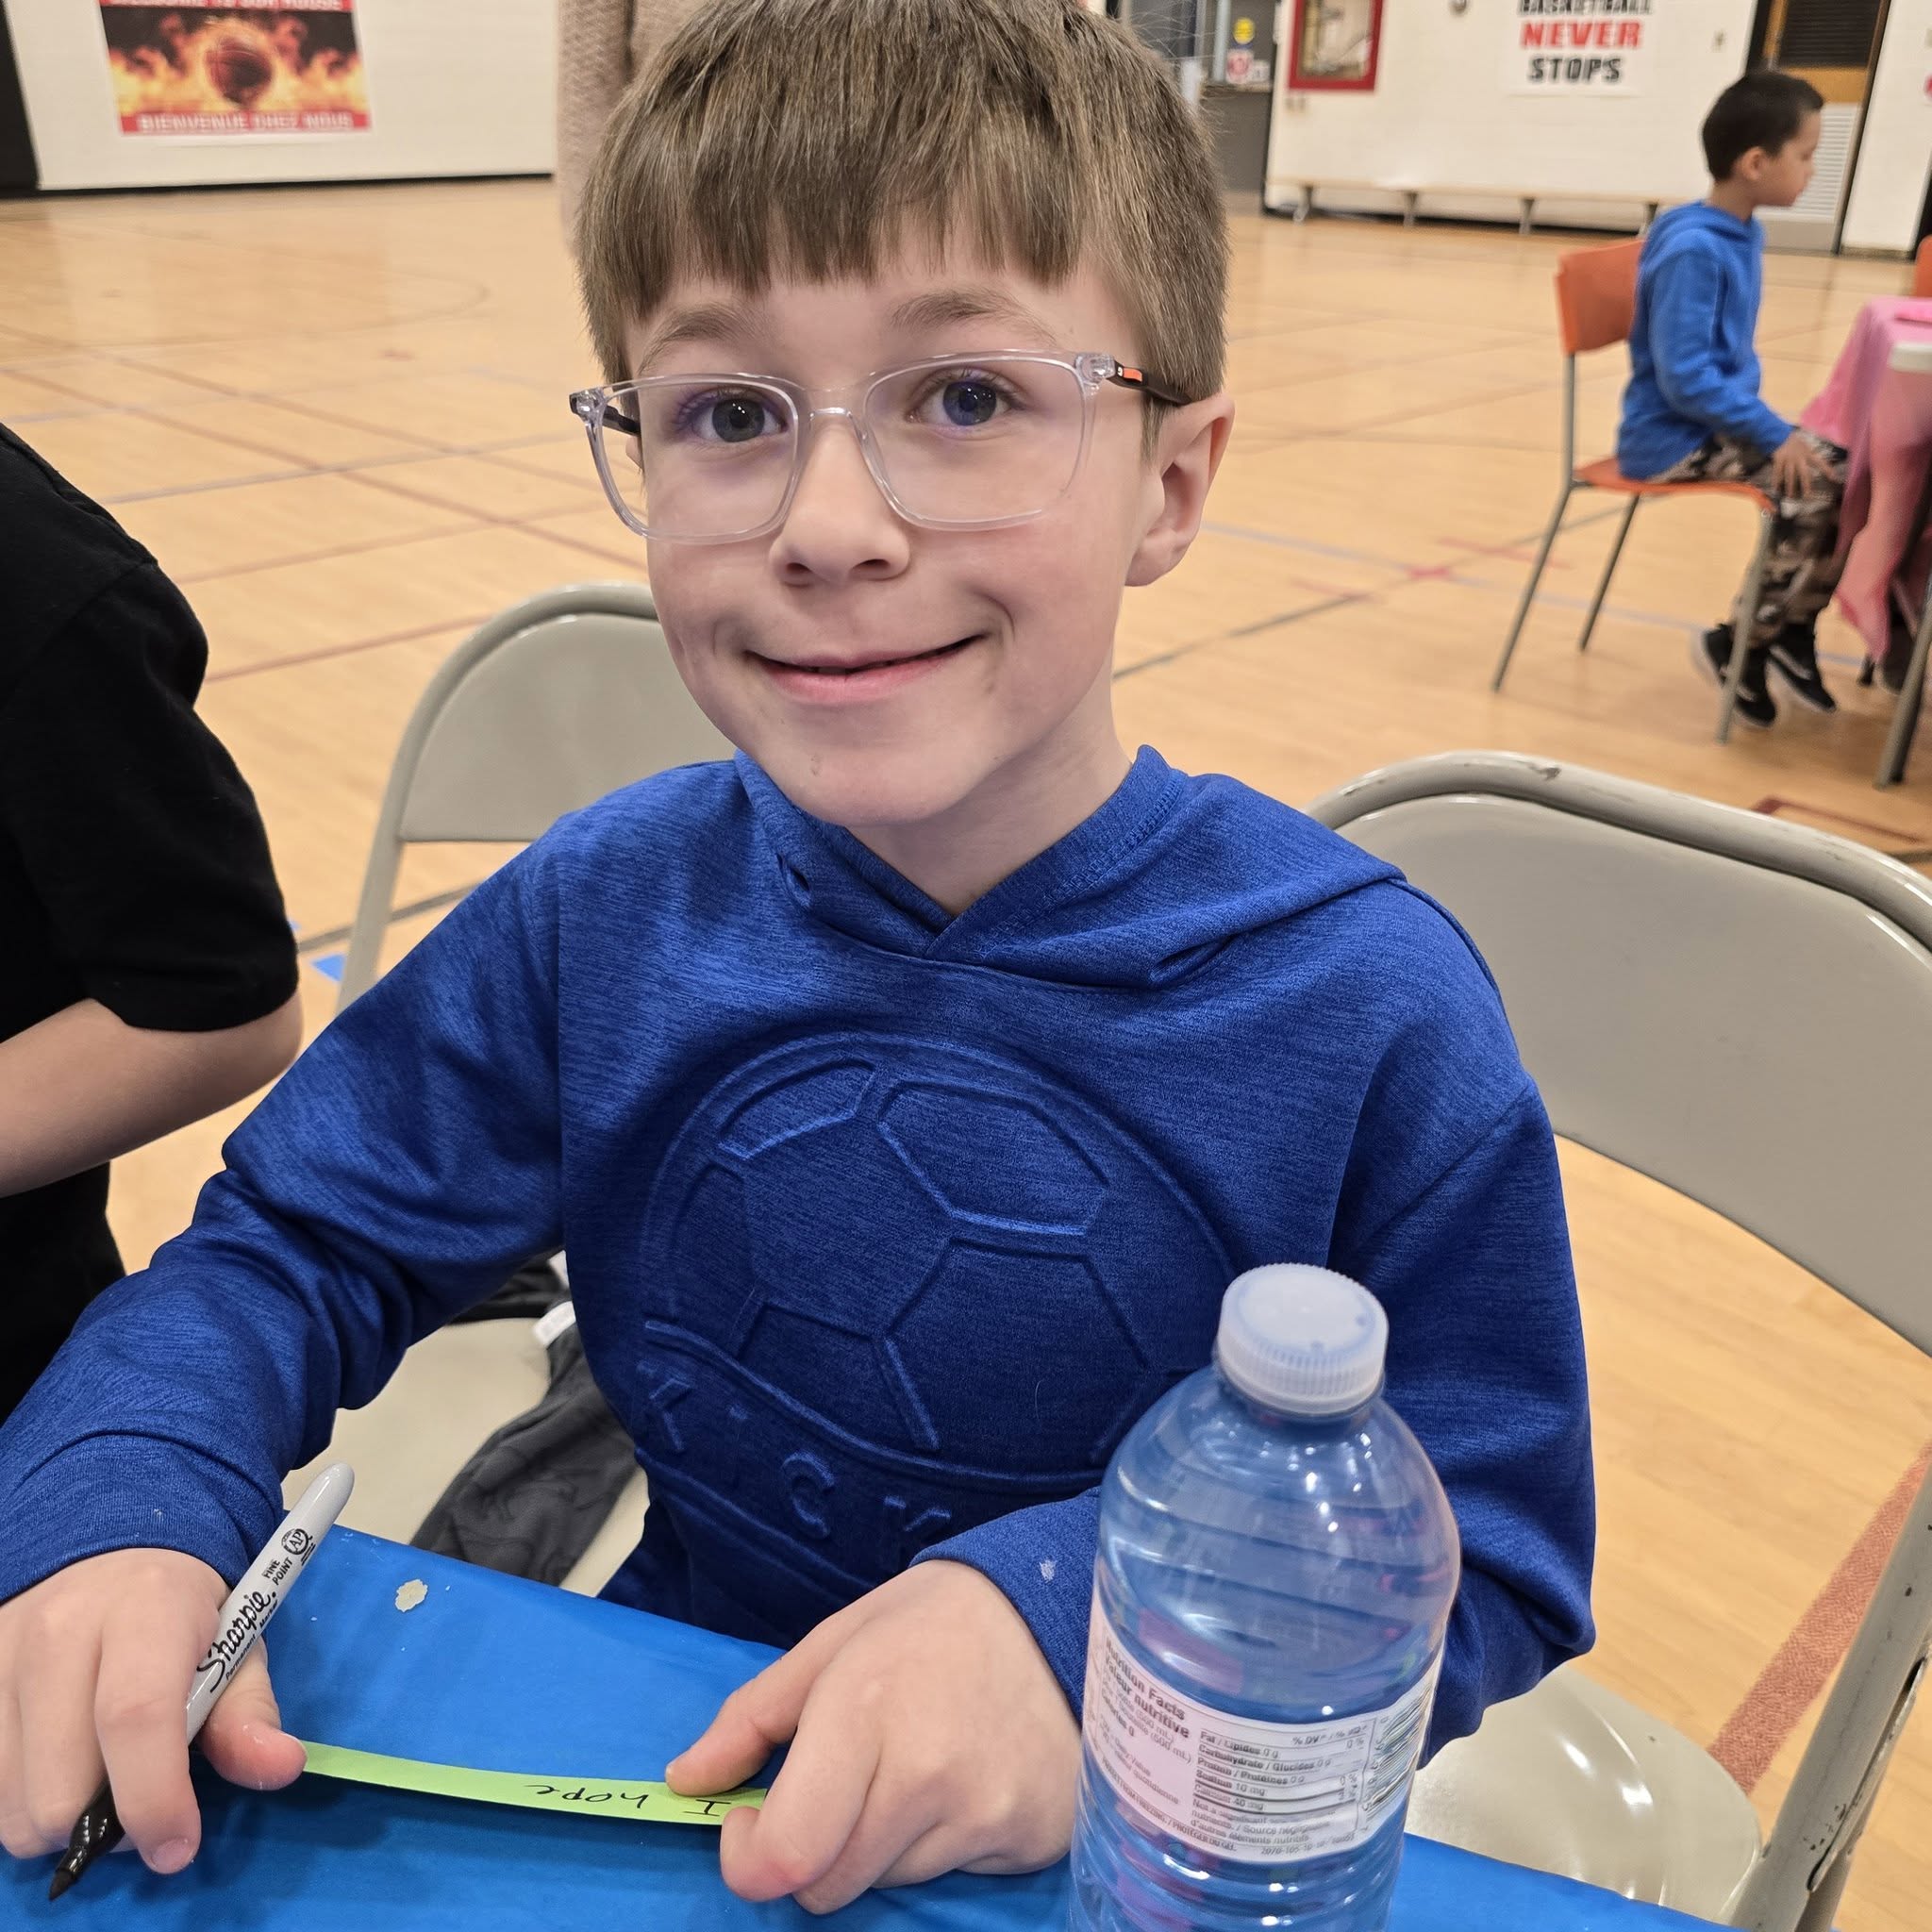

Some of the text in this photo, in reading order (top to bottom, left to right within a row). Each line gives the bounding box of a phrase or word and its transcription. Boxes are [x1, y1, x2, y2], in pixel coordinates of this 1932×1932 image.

[1521, 21, 1642, 48] NEVER
[1527, 56, 1622, 84] STOPS
[141, 112, 245, 130] BIENVENUE
[262, 1558, 280, 1579] FINE
[272, 1557, 293, 1586] POINT
[1134, 1693, 1190, 1738] nutritive
[1149, 1688, 1186, 1720] Facts
[1200, 1731, 1216, 1744] Fat
[1224, 1740, 1261, 1756] Lipides
[1198, 1743, 1264, 1770] Carbohydrate
[1273, 1761, 1315, 1772] Glucides
[1196, 1769, 1233, 1790] Sodium
[1236, 1782, 1248, 1792] 10
[525, 1784, 731, 1817] I hope
[1243, 1824, 1276, 1835] Source
